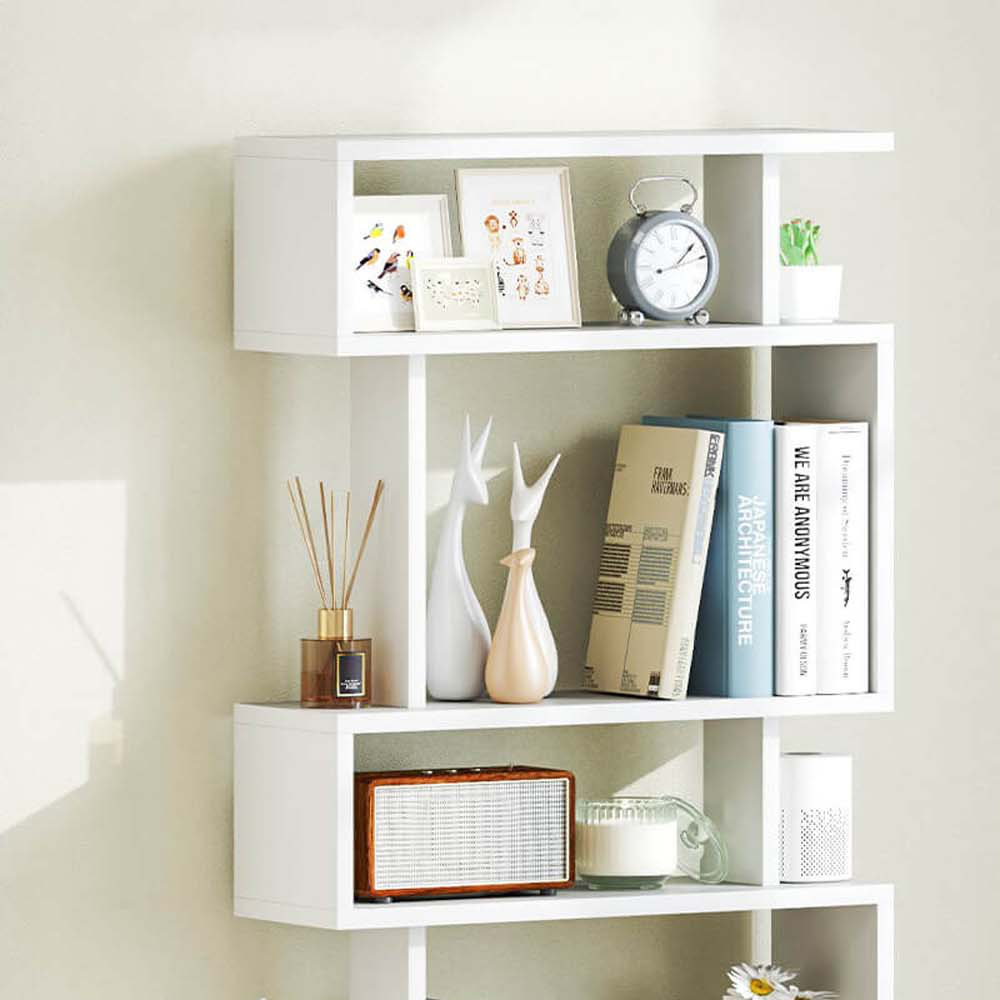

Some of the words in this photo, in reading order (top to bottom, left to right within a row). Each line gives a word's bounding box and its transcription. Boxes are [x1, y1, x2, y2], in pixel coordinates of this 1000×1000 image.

[794, 446, 810, 469] WE
[794, 473, 810, 502] ARE
[737, 495, 753, 647] ARCHITECTURE
[752, 495, 768, 595] JAPANESE
[794, 506, 810, 599] ANONYMOUS
